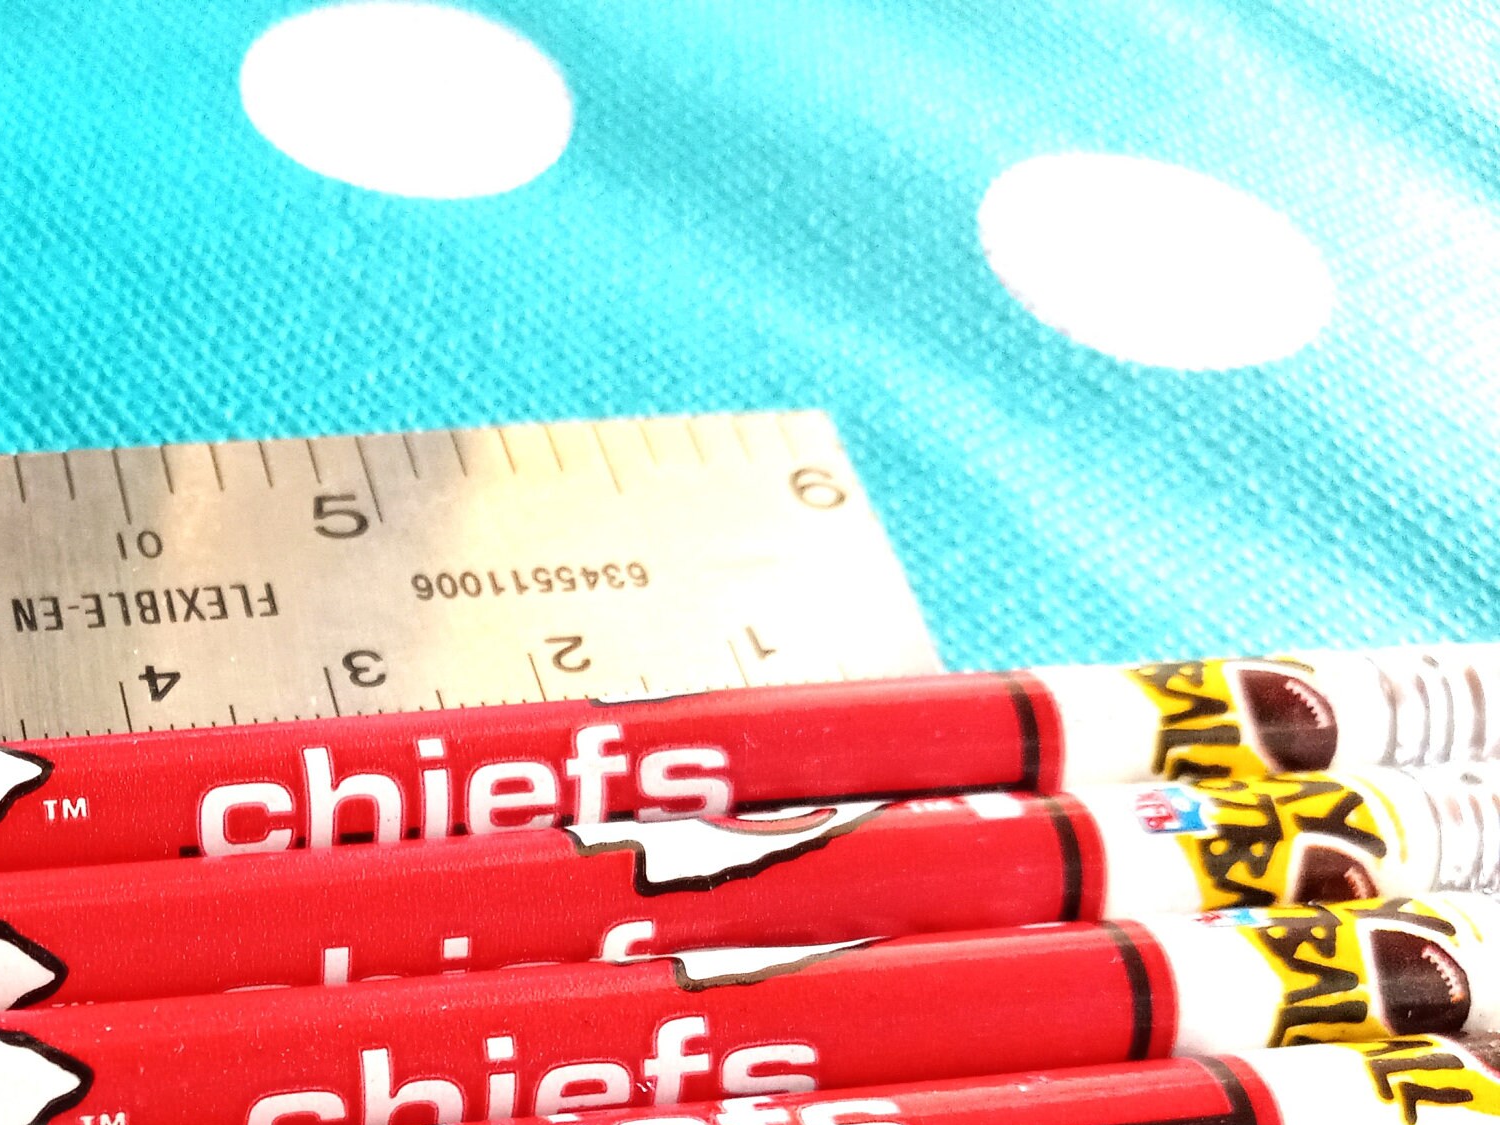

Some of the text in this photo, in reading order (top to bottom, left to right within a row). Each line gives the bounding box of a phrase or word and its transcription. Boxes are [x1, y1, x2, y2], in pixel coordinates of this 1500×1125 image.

[313, 493, 370, 540] 5
[789, 467, 846, 509] 6
[410, 560, 650, 601] 6345511006
[543, 635, 592, 673] 2
[745, 625, 777, 660] 1
[139, 664, 182, 703] 4
[341, 649, 387, 688] 3
[43, 797, 89, 822] TM
[199, 723, 735, 858] chiefs
